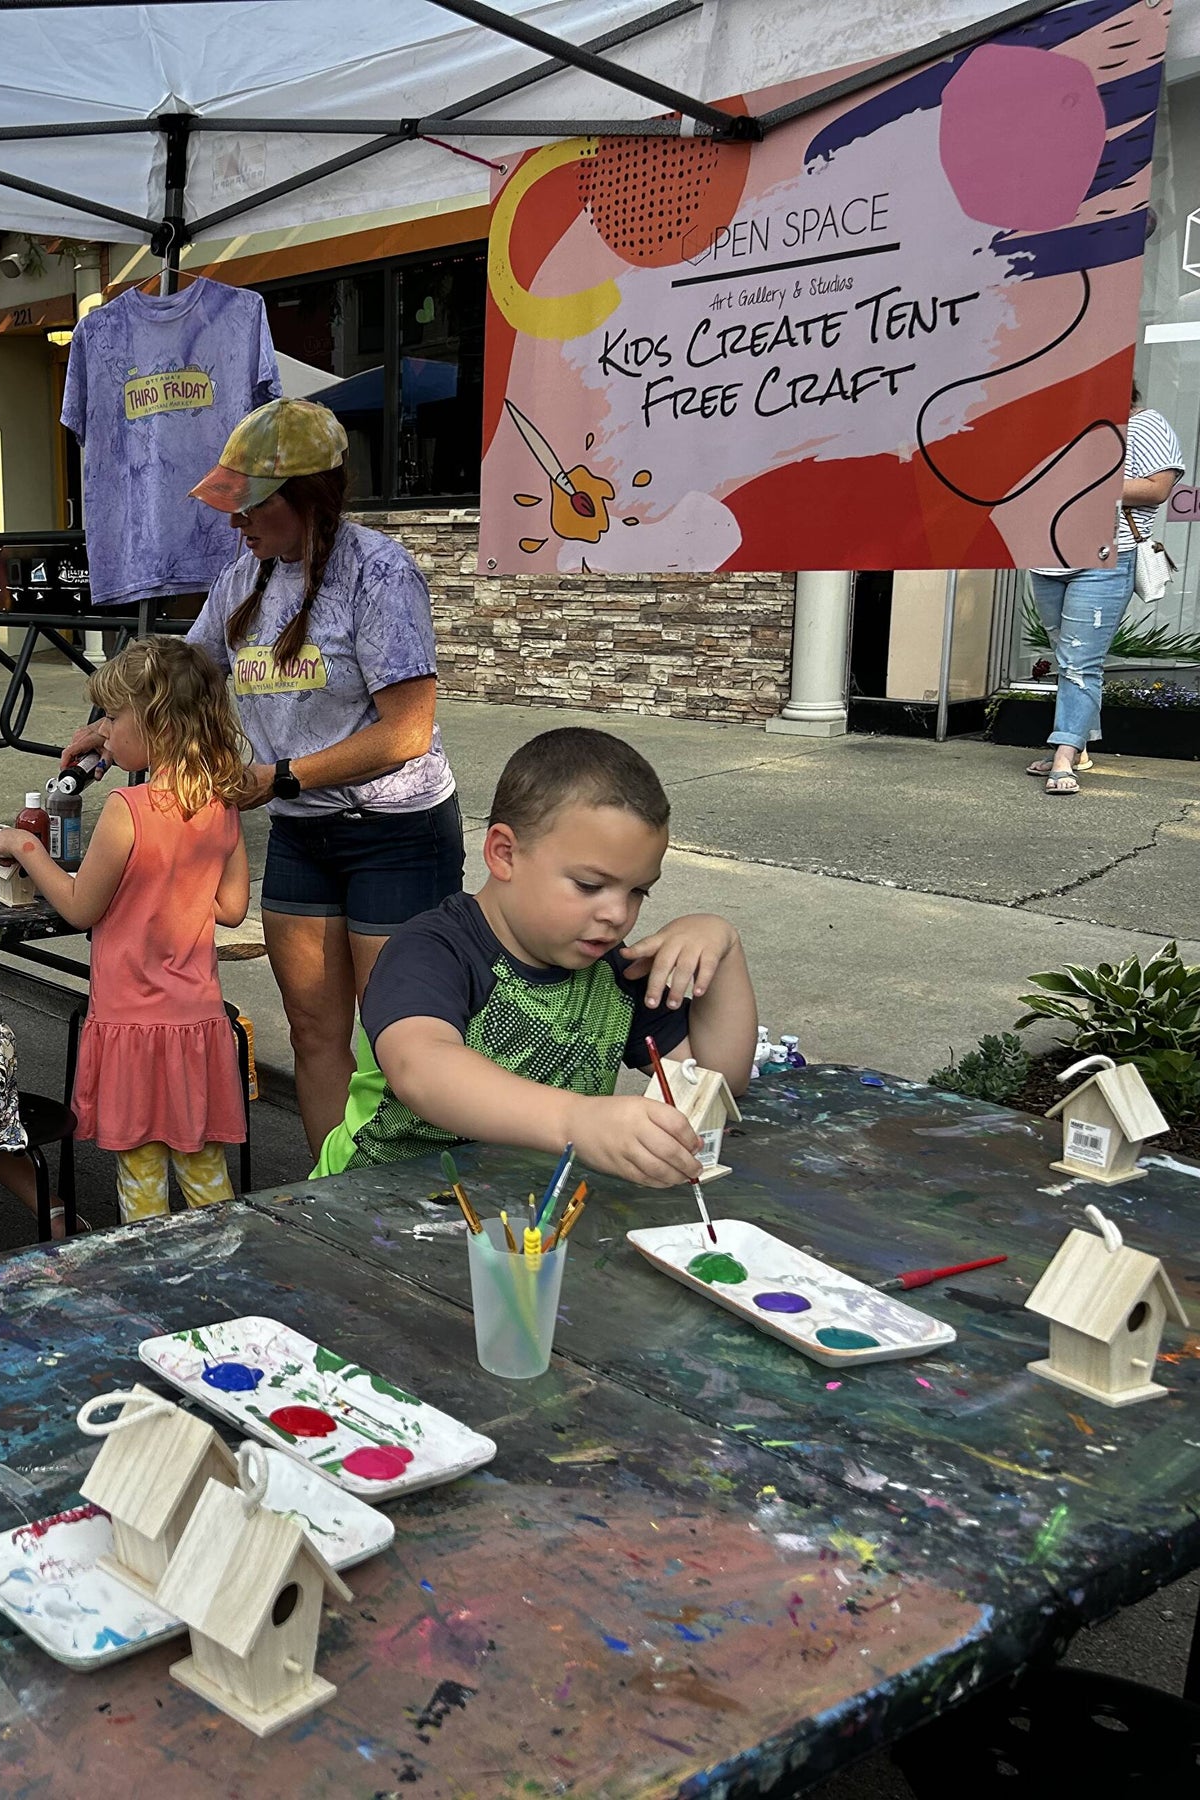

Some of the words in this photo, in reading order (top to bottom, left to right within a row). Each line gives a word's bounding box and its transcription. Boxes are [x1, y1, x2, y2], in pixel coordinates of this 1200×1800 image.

[782, 193, 889, 247] SPACE
[709, 292, 733, 311] Art
[738, 286, 787, 310] Gallery
[792, 281, 802, 299] &
[809, 274, 853, 296] Studios
[13, 307, 33, 327] 221
[598, 328, 673, 378] KIDS
[686, 310, 848, 368] CREATE
[855, 286, 980, 343] TENT
[127, 386, 158, 411] THIRD
[163, 381, 209, 400] FRIDAY
[641, 376, 743, 428] FREE
[754, 363, 917, 417] CRAFT
[1171, 489, 1200, 514] Cl
[237, 658, 267, 685] THIRD
